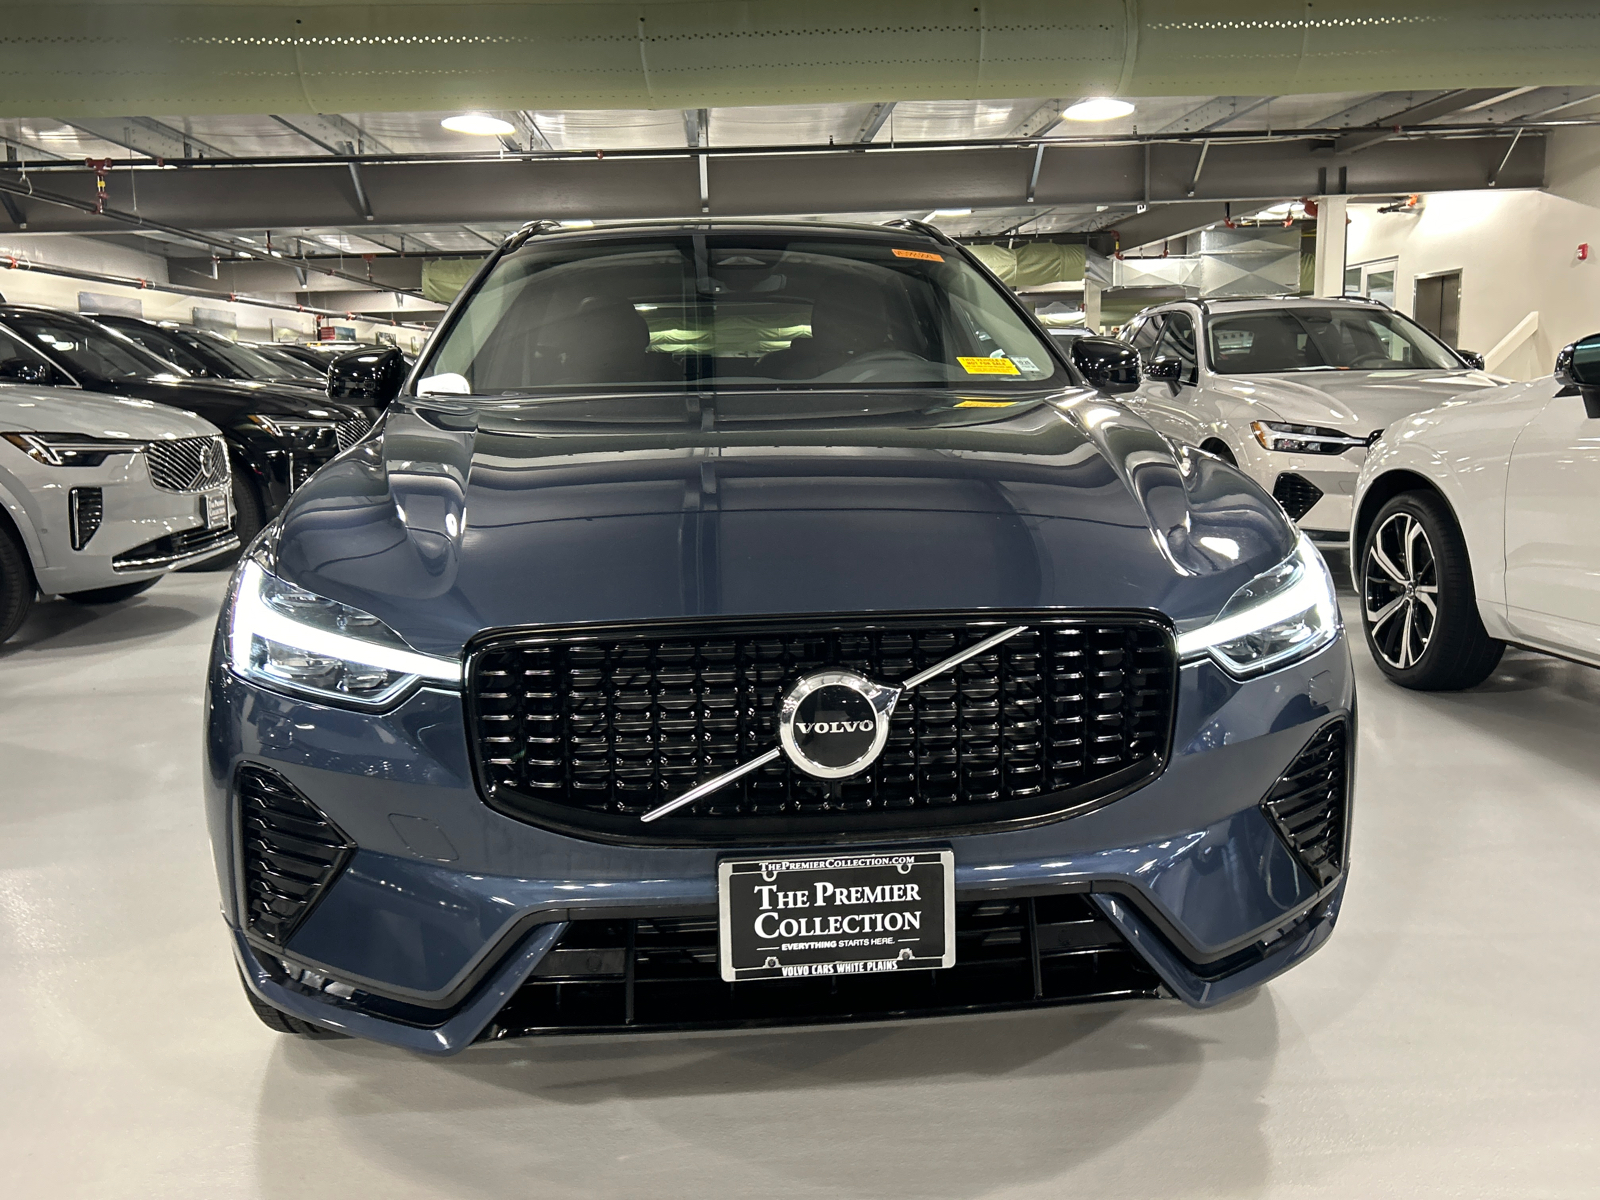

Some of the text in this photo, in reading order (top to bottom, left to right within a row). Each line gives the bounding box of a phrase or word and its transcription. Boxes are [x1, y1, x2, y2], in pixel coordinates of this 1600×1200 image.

[796, 720, 874, 734] VOLVO
[754, 882, 921, 910] THE PREMIER
[754, 911, 921, 938] COLLECTION
[782, 937, 895, 950] EVERYTHING STARTS HERE.
[782, 960, 898, 976] VOLVO CARS WHITE PLAINS
